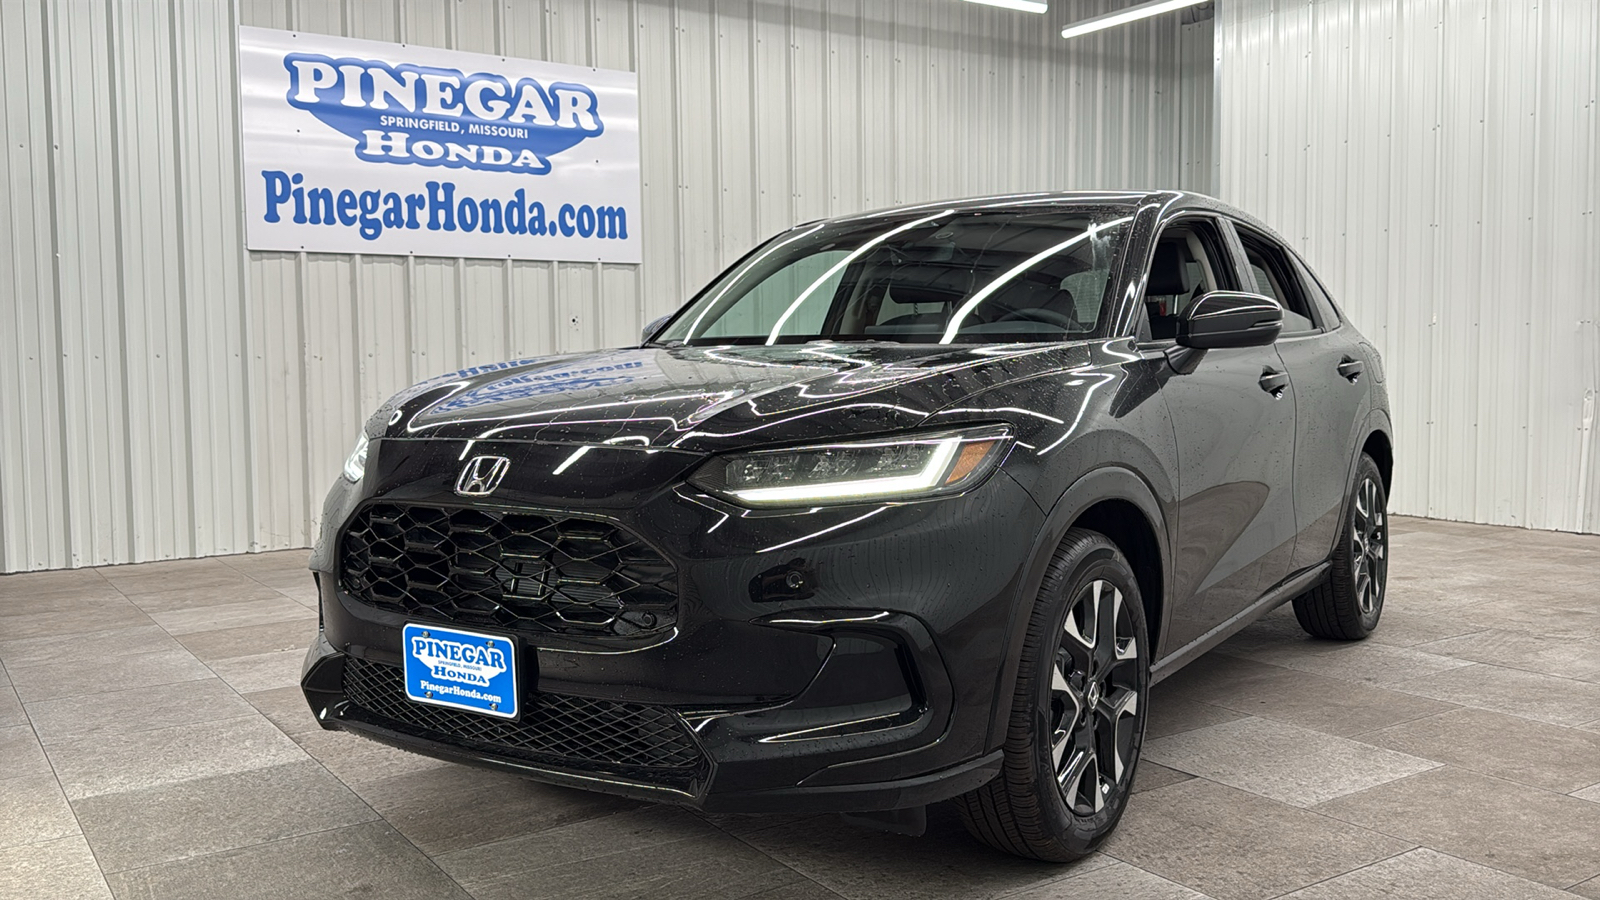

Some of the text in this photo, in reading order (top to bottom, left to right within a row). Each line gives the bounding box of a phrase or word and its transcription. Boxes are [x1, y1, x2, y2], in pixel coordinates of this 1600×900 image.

[292, 60, 598, 131] PINEGAR
[380, 115, 528, 139] SPRINGFIELD, MISSOURI
[362, 130, 545, 168] HONDA
[261, 170, 628, 240] PinegarHonda.com
[414, 639, 504, 669] PINEGAR
[433, 665, 487, 684] HONDA
[420, 680, 501, 703] PinegarHonda.com
